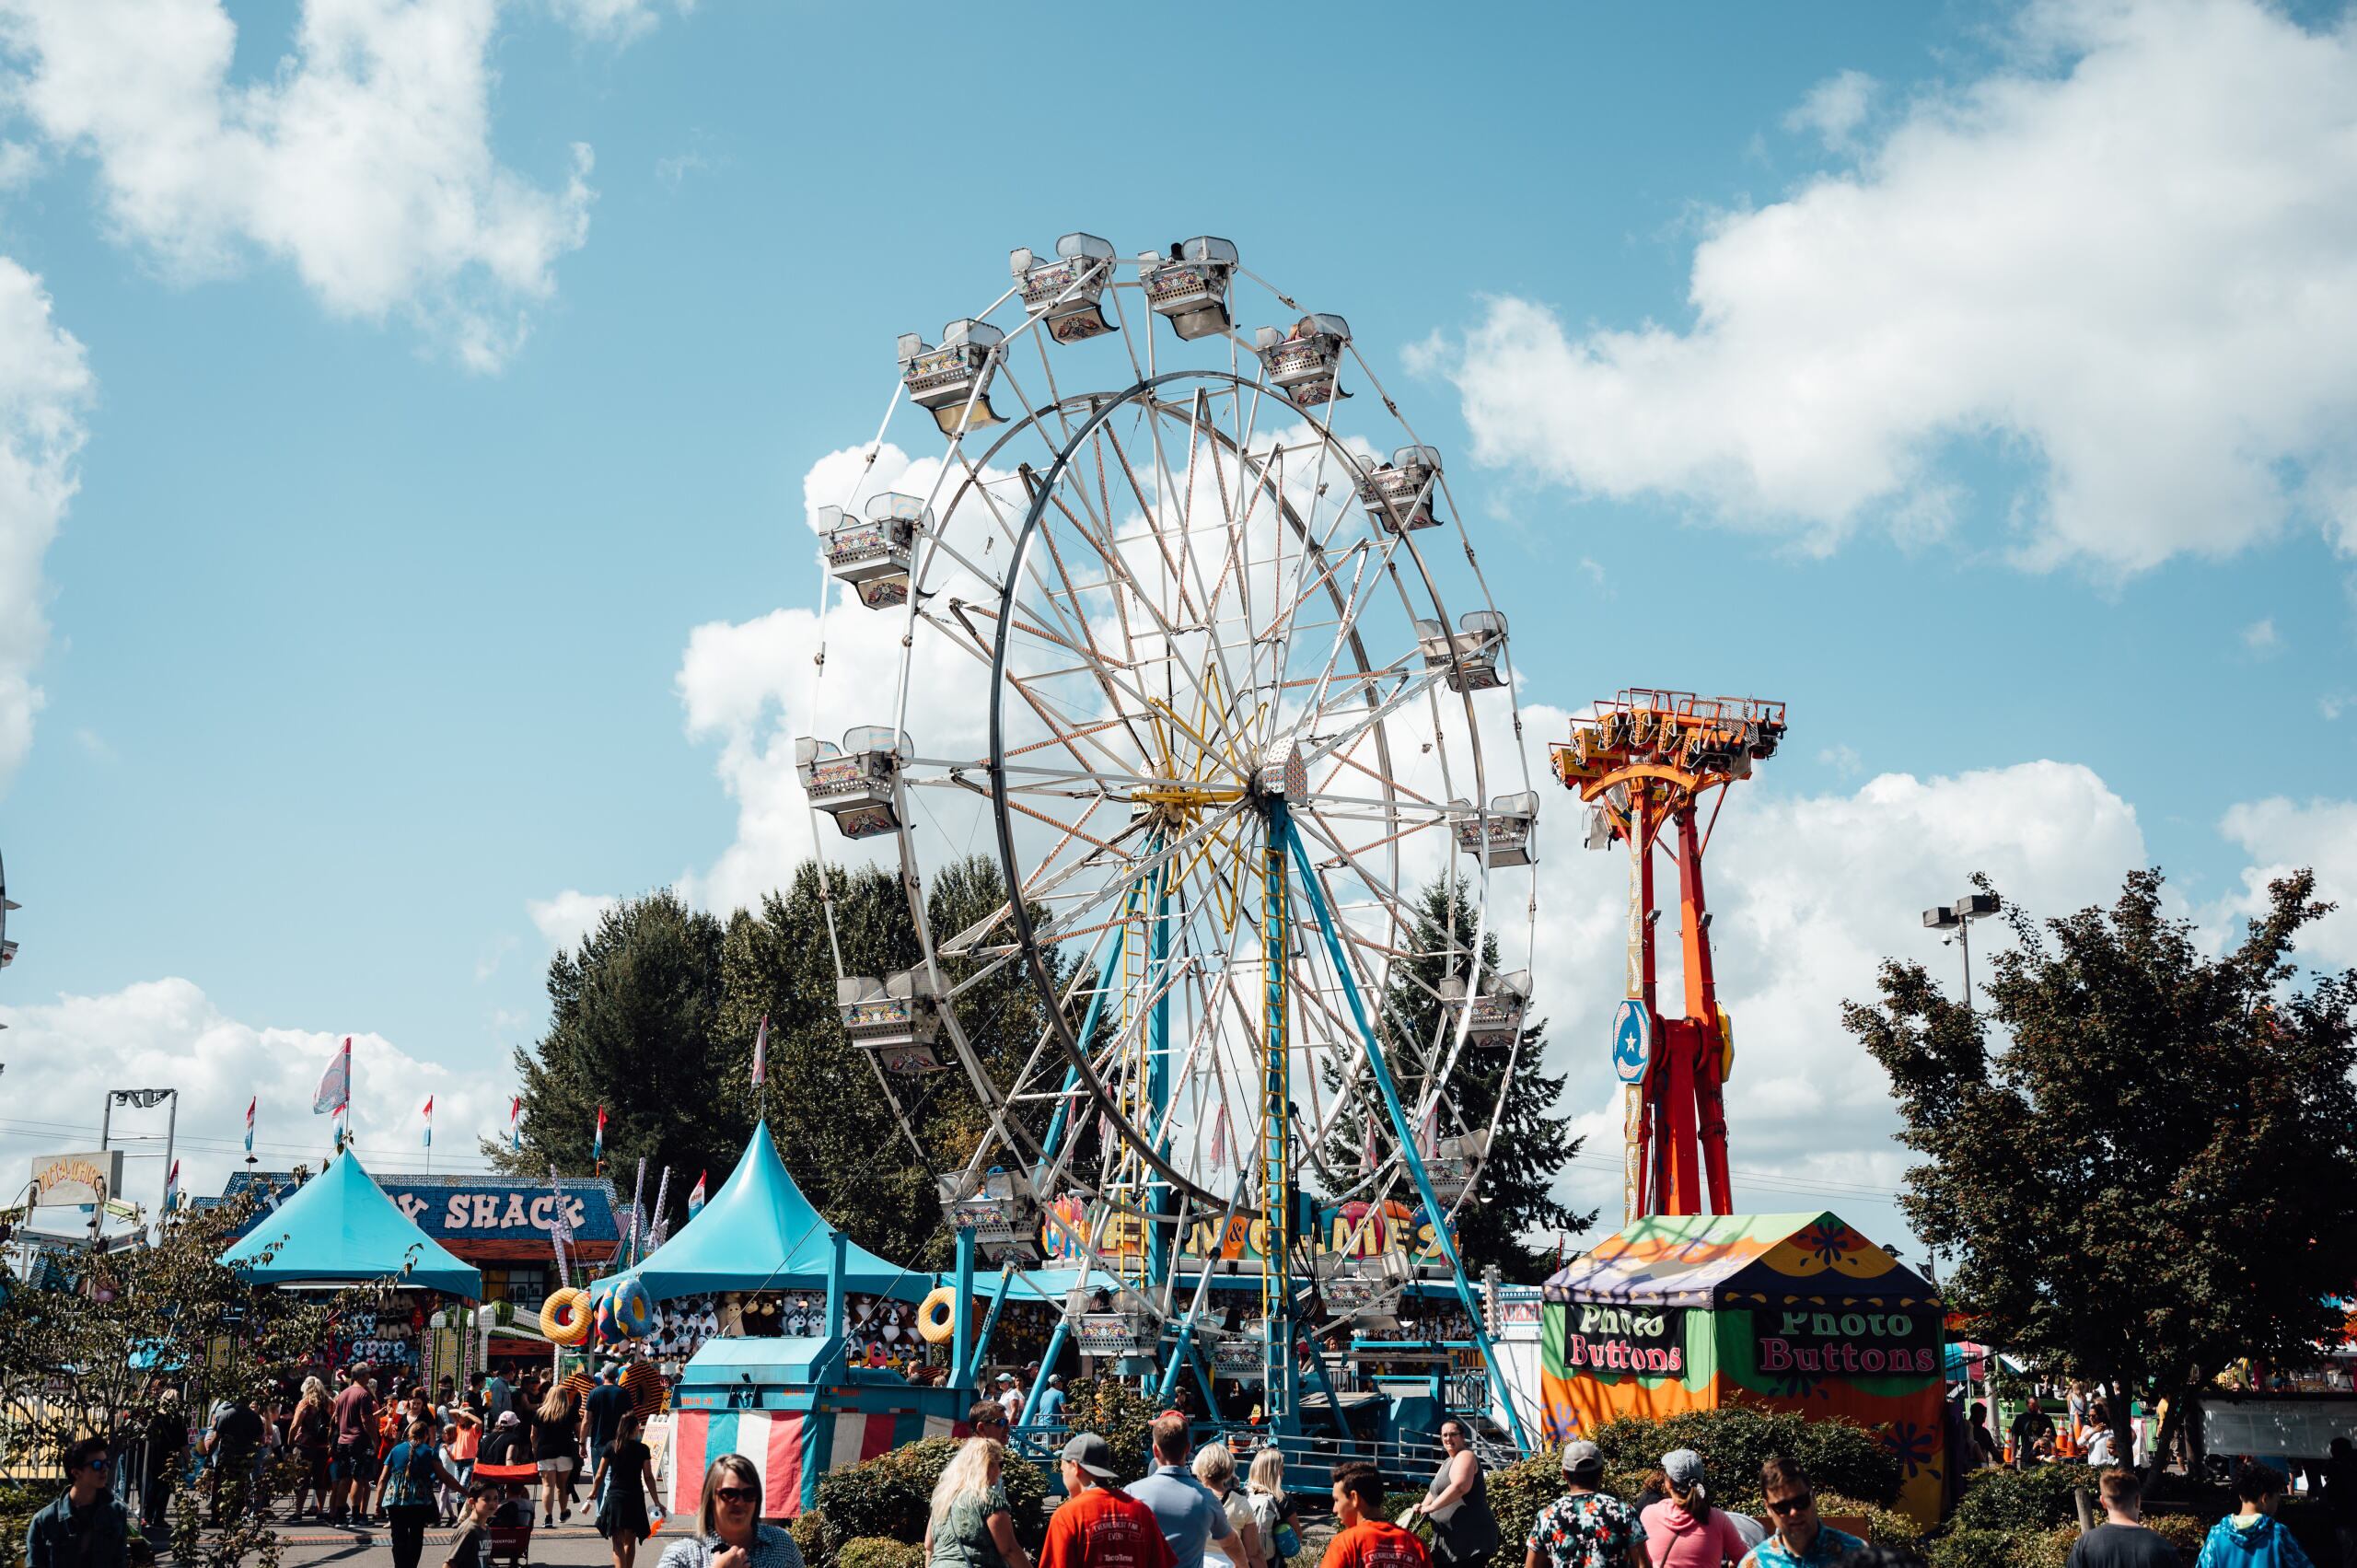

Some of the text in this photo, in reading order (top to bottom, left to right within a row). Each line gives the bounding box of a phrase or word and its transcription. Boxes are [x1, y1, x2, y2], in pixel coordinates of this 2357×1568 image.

[445, 1193, 586, 1229] SHACK
[1101, 1212, 1227, 1258] FN
[1228, 1222, 1242, 1243] &
[1579, 1304, 1665, 1337] Photo
[1780, 1311, 1913, 1336] Photo
[424, 1330, 434, 1369] PRIZE
[465, 1330, 474, 1368] PRIZE
[1457, 1348, 1480, 1366] EXIT
[1570, 1333, 1682, 1371] Buttons
[1759, 1338, 1935, 1372] Buttons
[188, 1411, 199, 1443] TIME
